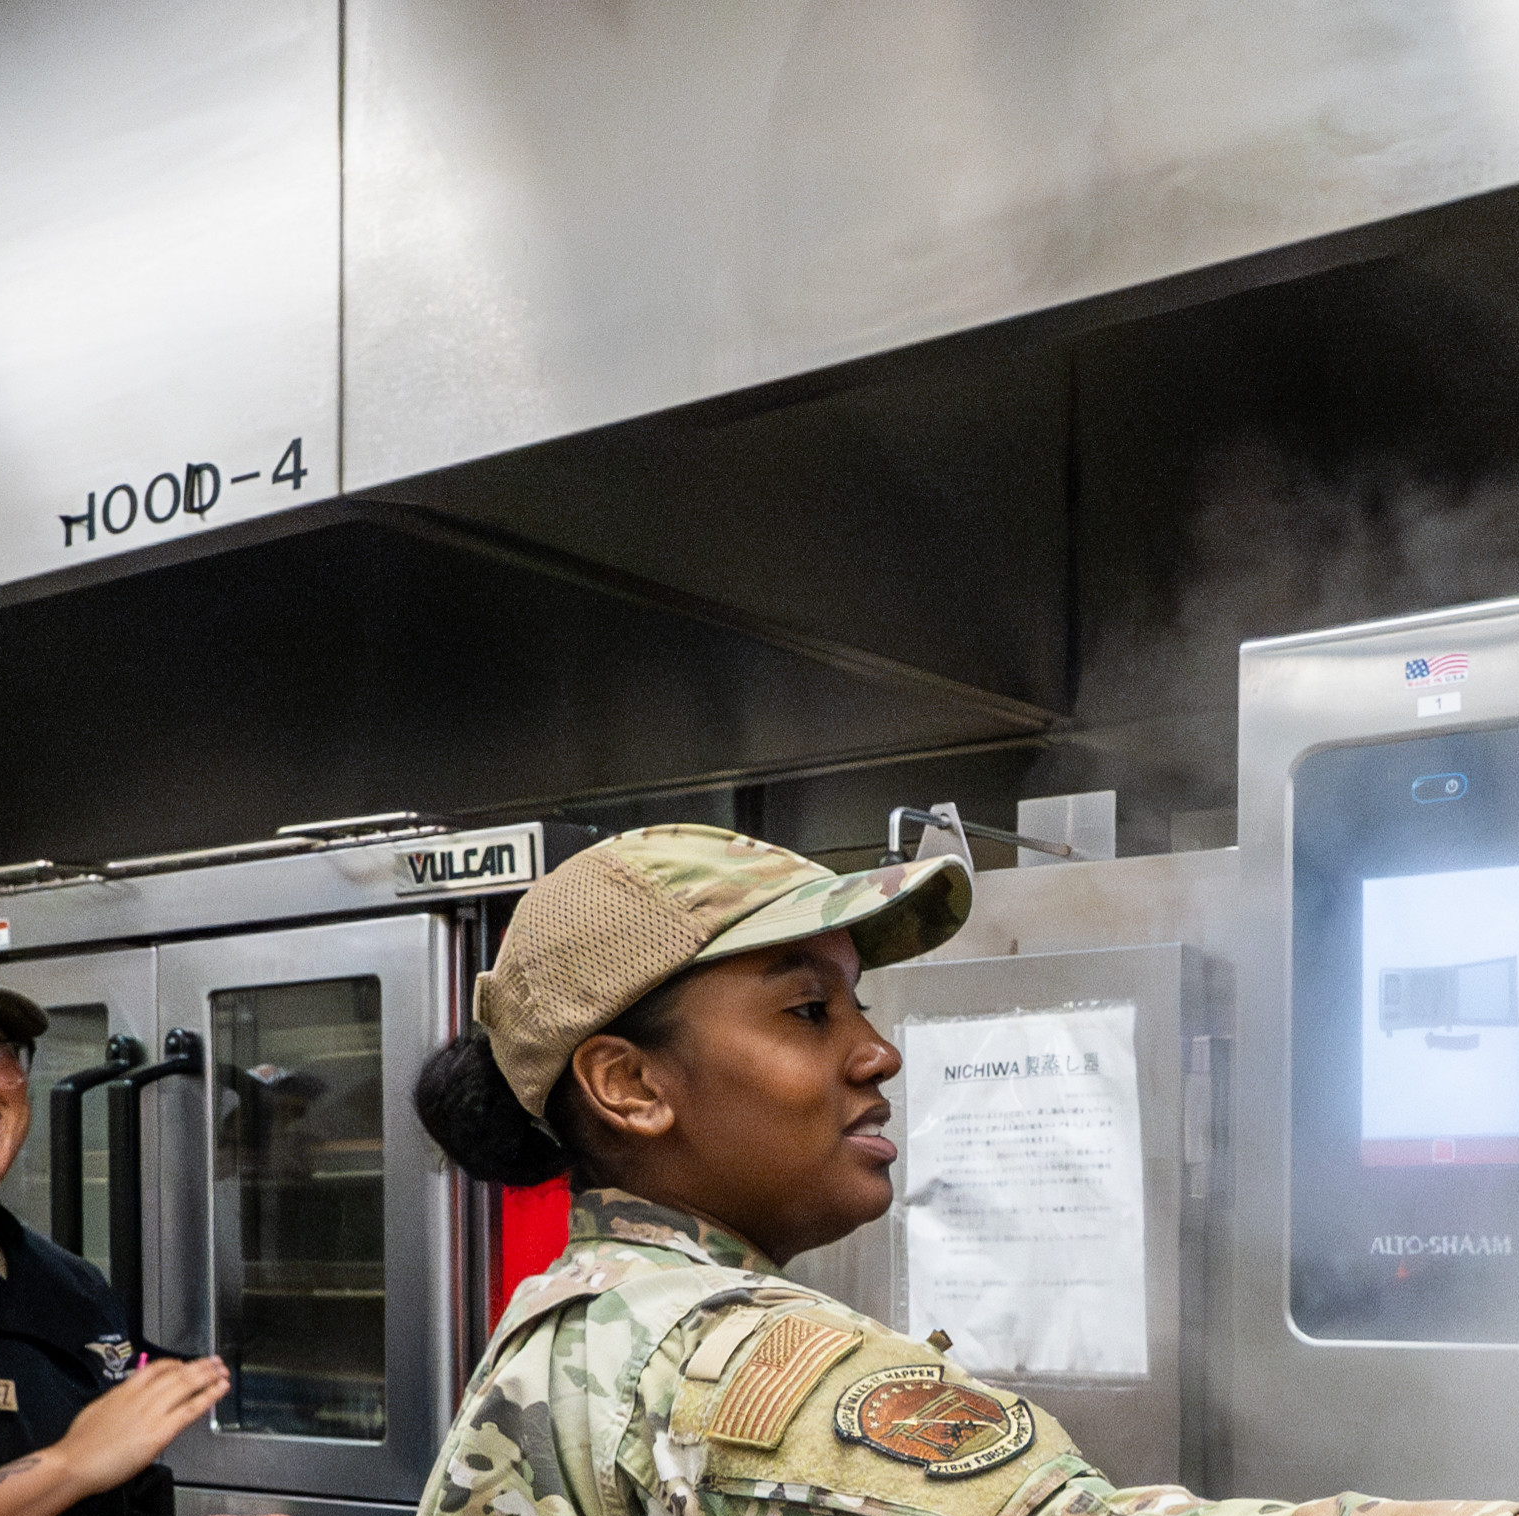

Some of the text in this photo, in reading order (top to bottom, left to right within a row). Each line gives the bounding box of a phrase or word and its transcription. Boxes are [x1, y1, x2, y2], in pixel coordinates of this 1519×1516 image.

[59, 437, 308, 548] HOOD-4
[407, 843, 515, 884] VULCAN
[944, 1061, 1020, 1081] NICHIWA
